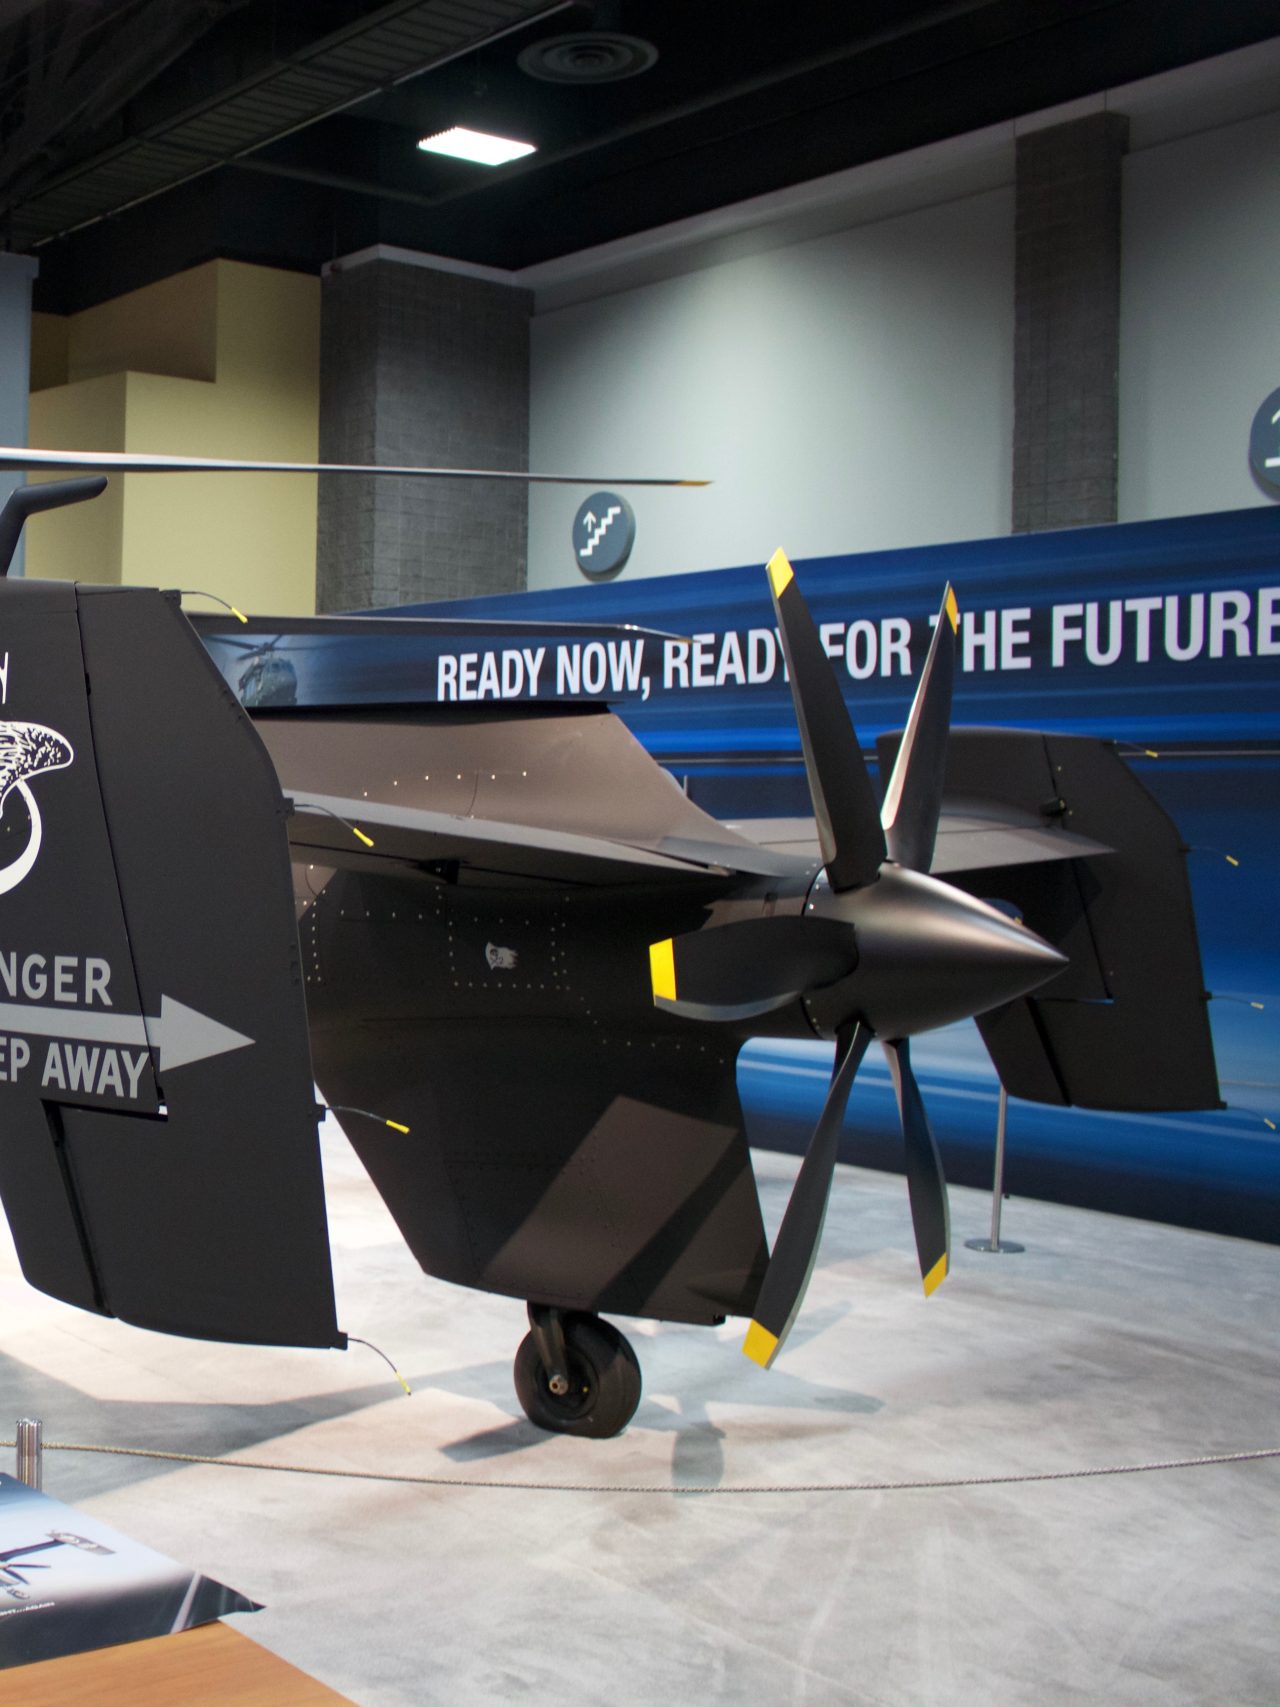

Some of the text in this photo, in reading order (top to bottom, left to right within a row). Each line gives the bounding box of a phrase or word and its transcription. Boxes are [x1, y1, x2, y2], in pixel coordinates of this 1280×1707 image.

[437, 645, 545, 702] READY
[556, 638, 650, 702] NOW,
[663, 626, 789, 690] READ
[819, 616, 912, 680] FOR
[1052, 586, 1280, 669] FUTURE
[41, 1041, 150, 1099] AWAY
